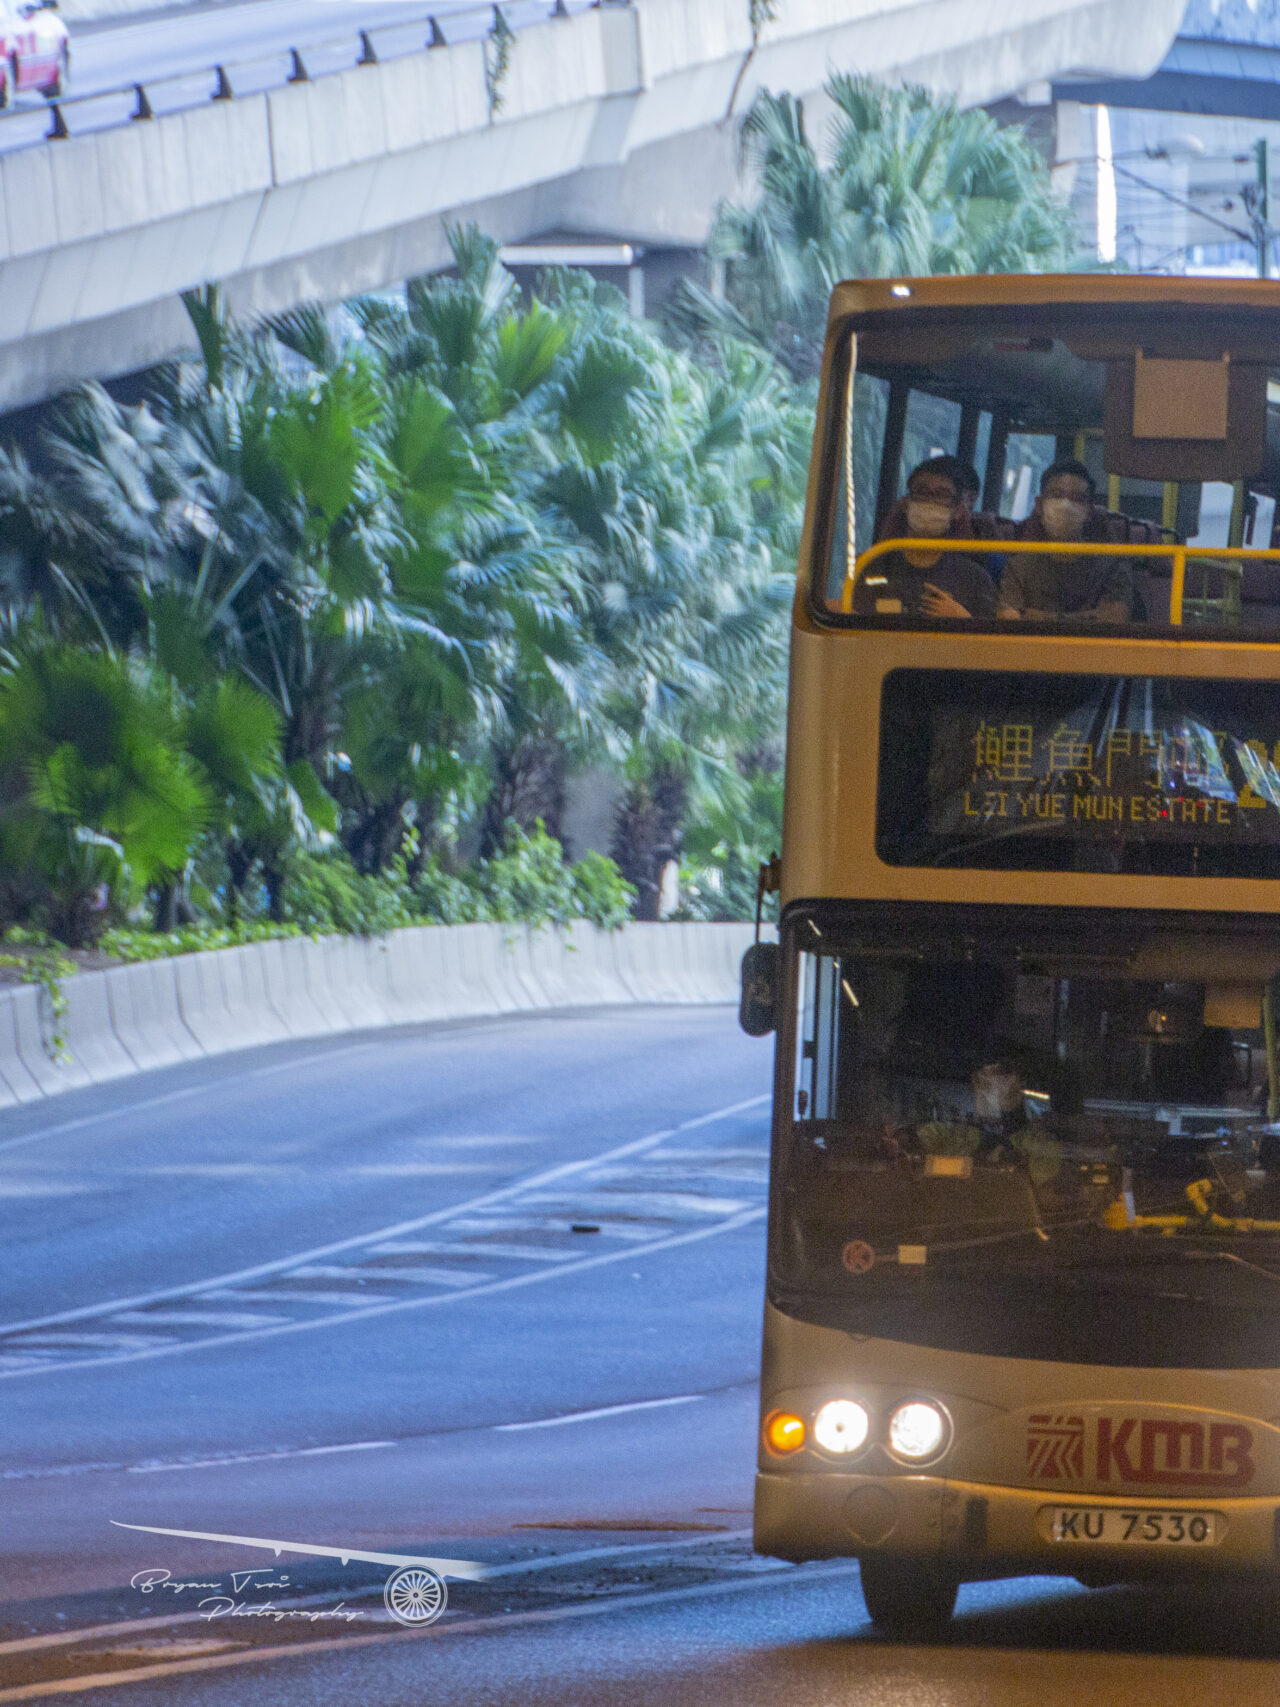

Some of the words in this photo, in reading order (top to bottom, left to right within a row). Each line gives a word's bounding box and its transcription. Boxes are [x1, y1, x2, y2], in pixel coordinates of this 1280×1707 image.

[964, 791, 1008, 817] LEI
[1016, 792, 1066, 819] YUE
[1073, 794, 1124, 821] MUN
[1130, 796, 1232, 824] ESTATE
[1097, 1416, 1255, 1488] KMB
[1060, 1512, 1105, 1540] KU
[1120, 1513, 1209, 1543] 7530
